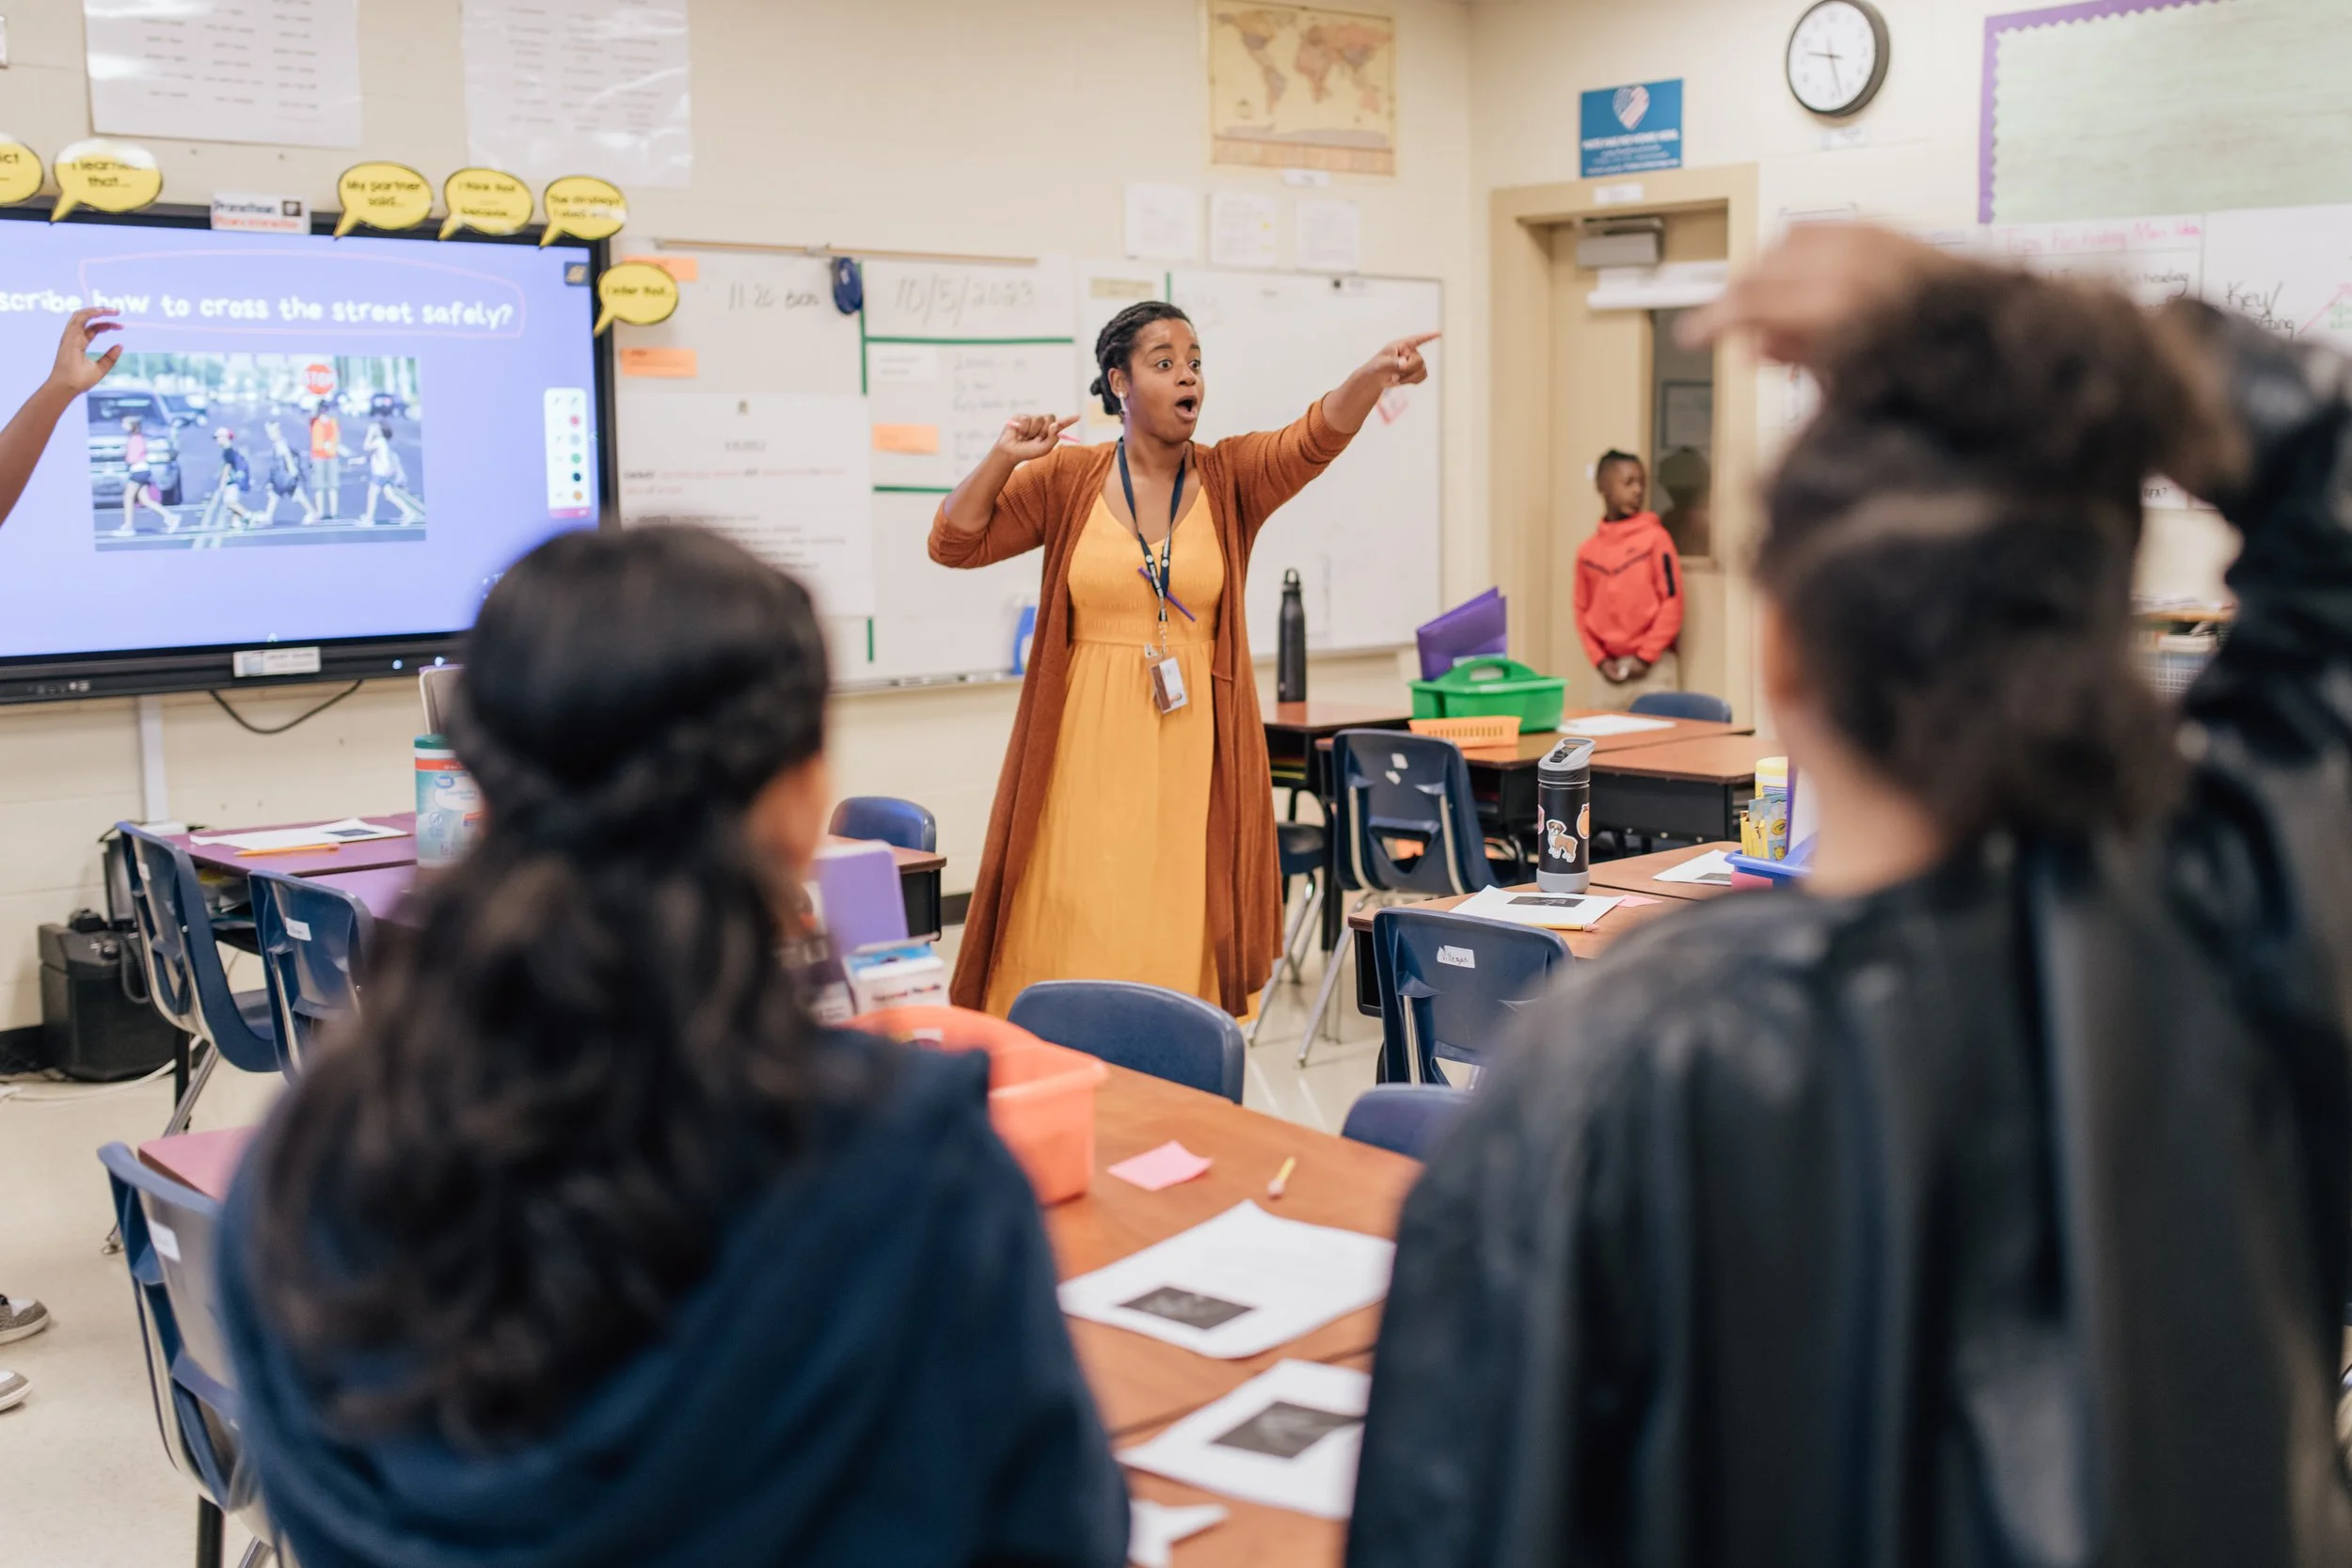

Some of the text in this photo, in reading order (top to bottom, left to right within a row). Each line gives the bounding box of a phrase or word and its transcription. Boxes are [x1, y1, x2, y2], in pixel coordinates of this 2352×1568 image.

[161, 293, 191, 319] to
[199, 297, 271, 320] cross
[278, 294, 324, 322] the
[332, 299, 415, 325] street
[421, 300, 515, 331] safely?
